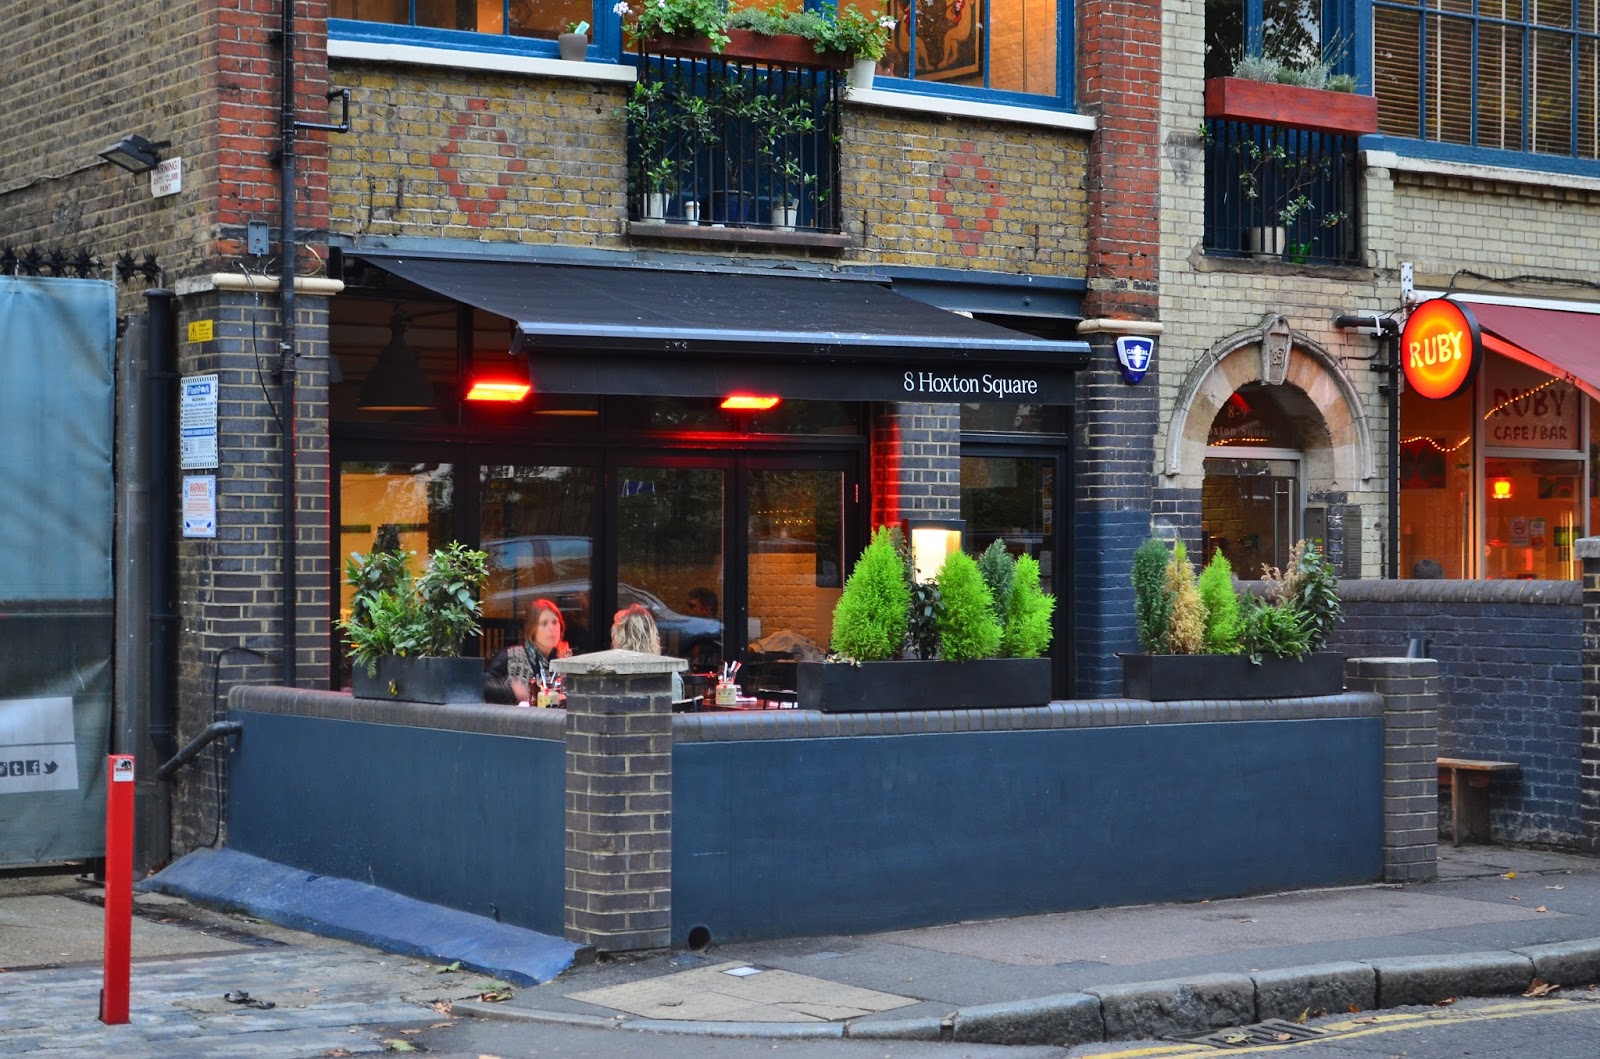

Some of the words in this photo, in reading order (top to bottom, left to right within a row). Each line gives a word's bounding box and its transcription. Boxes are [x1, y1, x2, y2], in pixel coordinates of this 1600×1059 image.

[1409, 330, 1463, 369] RUBY
[903, 371, 915, 391] 8
[918, 372, 979, 393] Hoxton
[982, 374, 1038, 398] Square
[1494, 388, 1566, 417] RUBY
